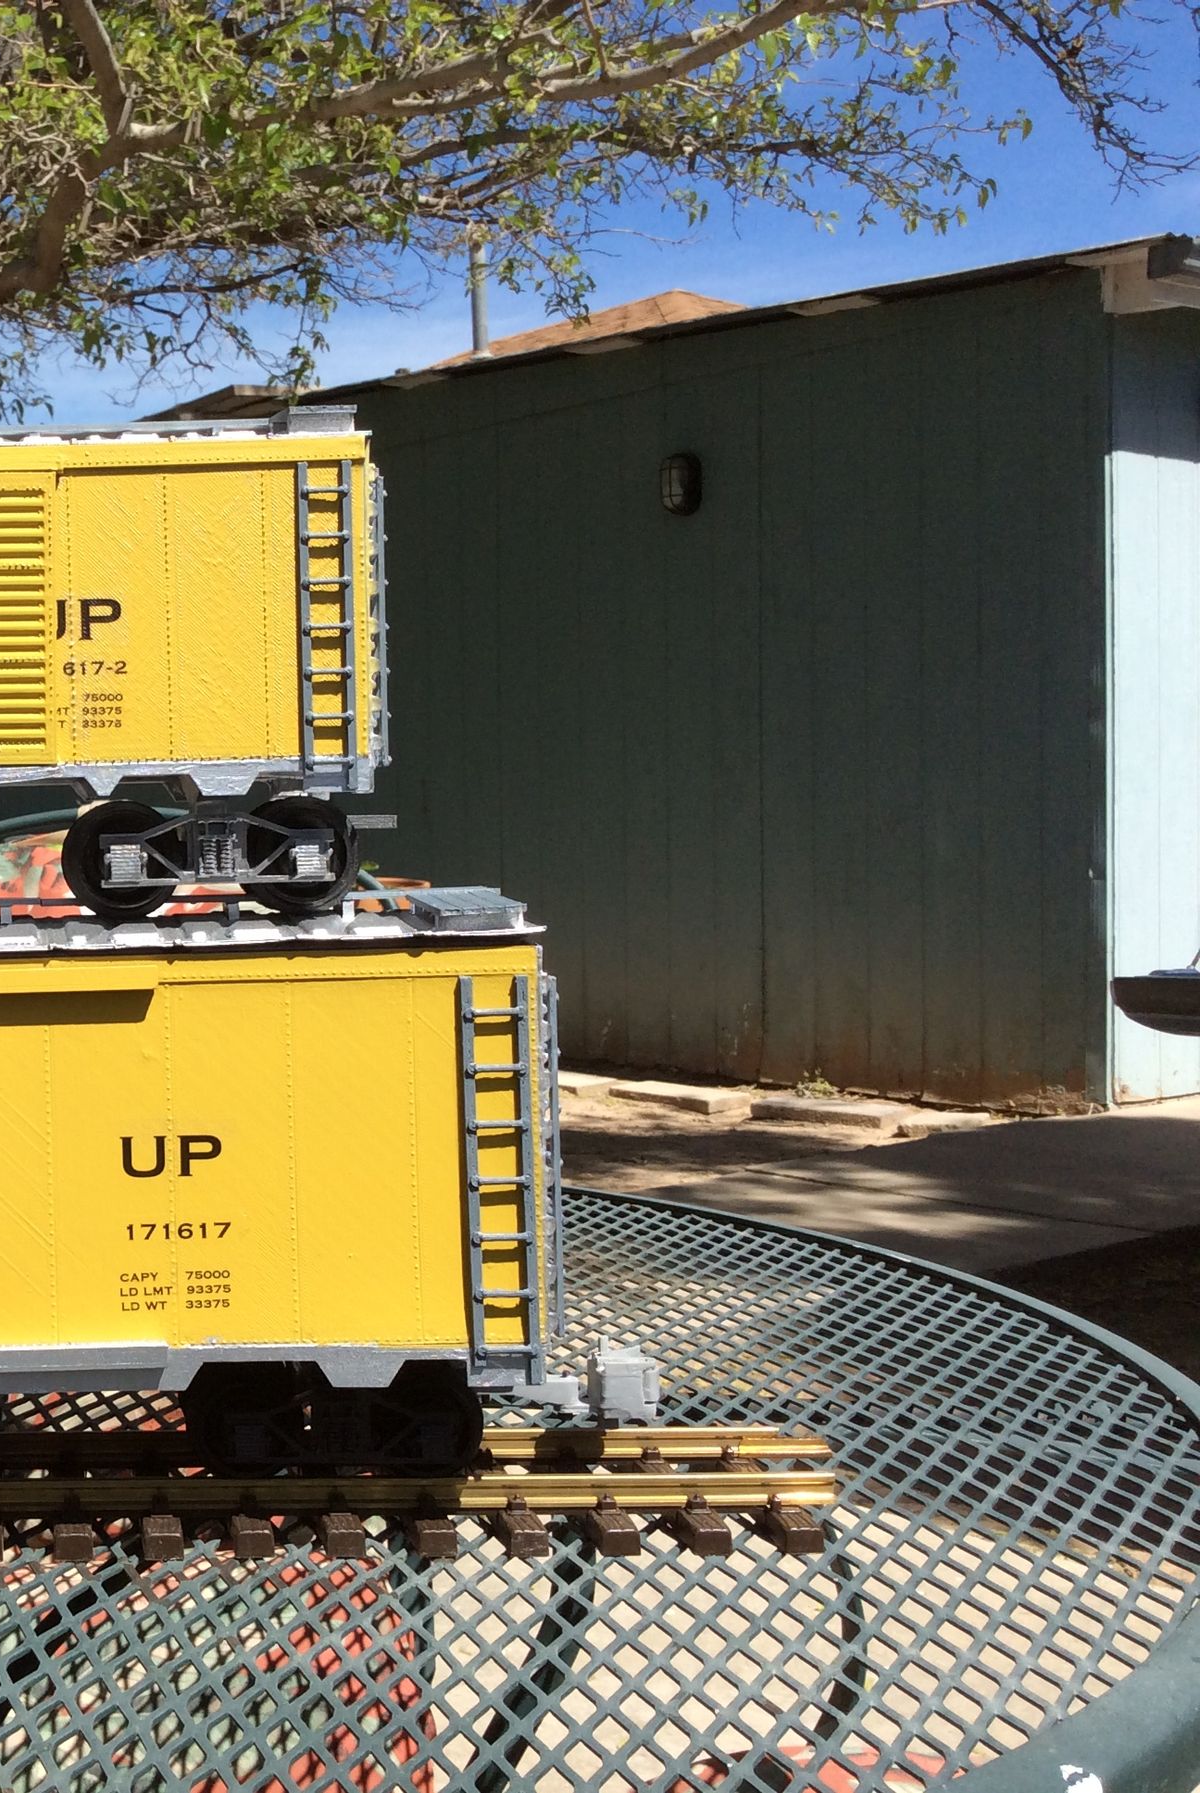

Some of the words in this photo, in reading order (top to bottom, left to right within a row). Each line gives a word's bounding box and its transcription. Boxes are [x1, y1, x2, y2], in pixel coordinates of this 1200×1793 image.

[83, 693, 124, 702] 75000
[82, 706, 122, 716] 93375
[119, 1134, 222, 1178] UP
[127, 1221, 231, 1241] 171617
[120, 1272, 159, 1282] CAPY
[185, 1269, 231, 1280] 75000
[120, 1286, 138, 1297] LD
[143, 1285, 173, 1296] LMT
[187, 1284, 232, 1294] 93375
[121, 1301, 140, 1312] LD
[146, 1300, 168, 1311] WT
[185, 1298, 231, 1309] 33375
